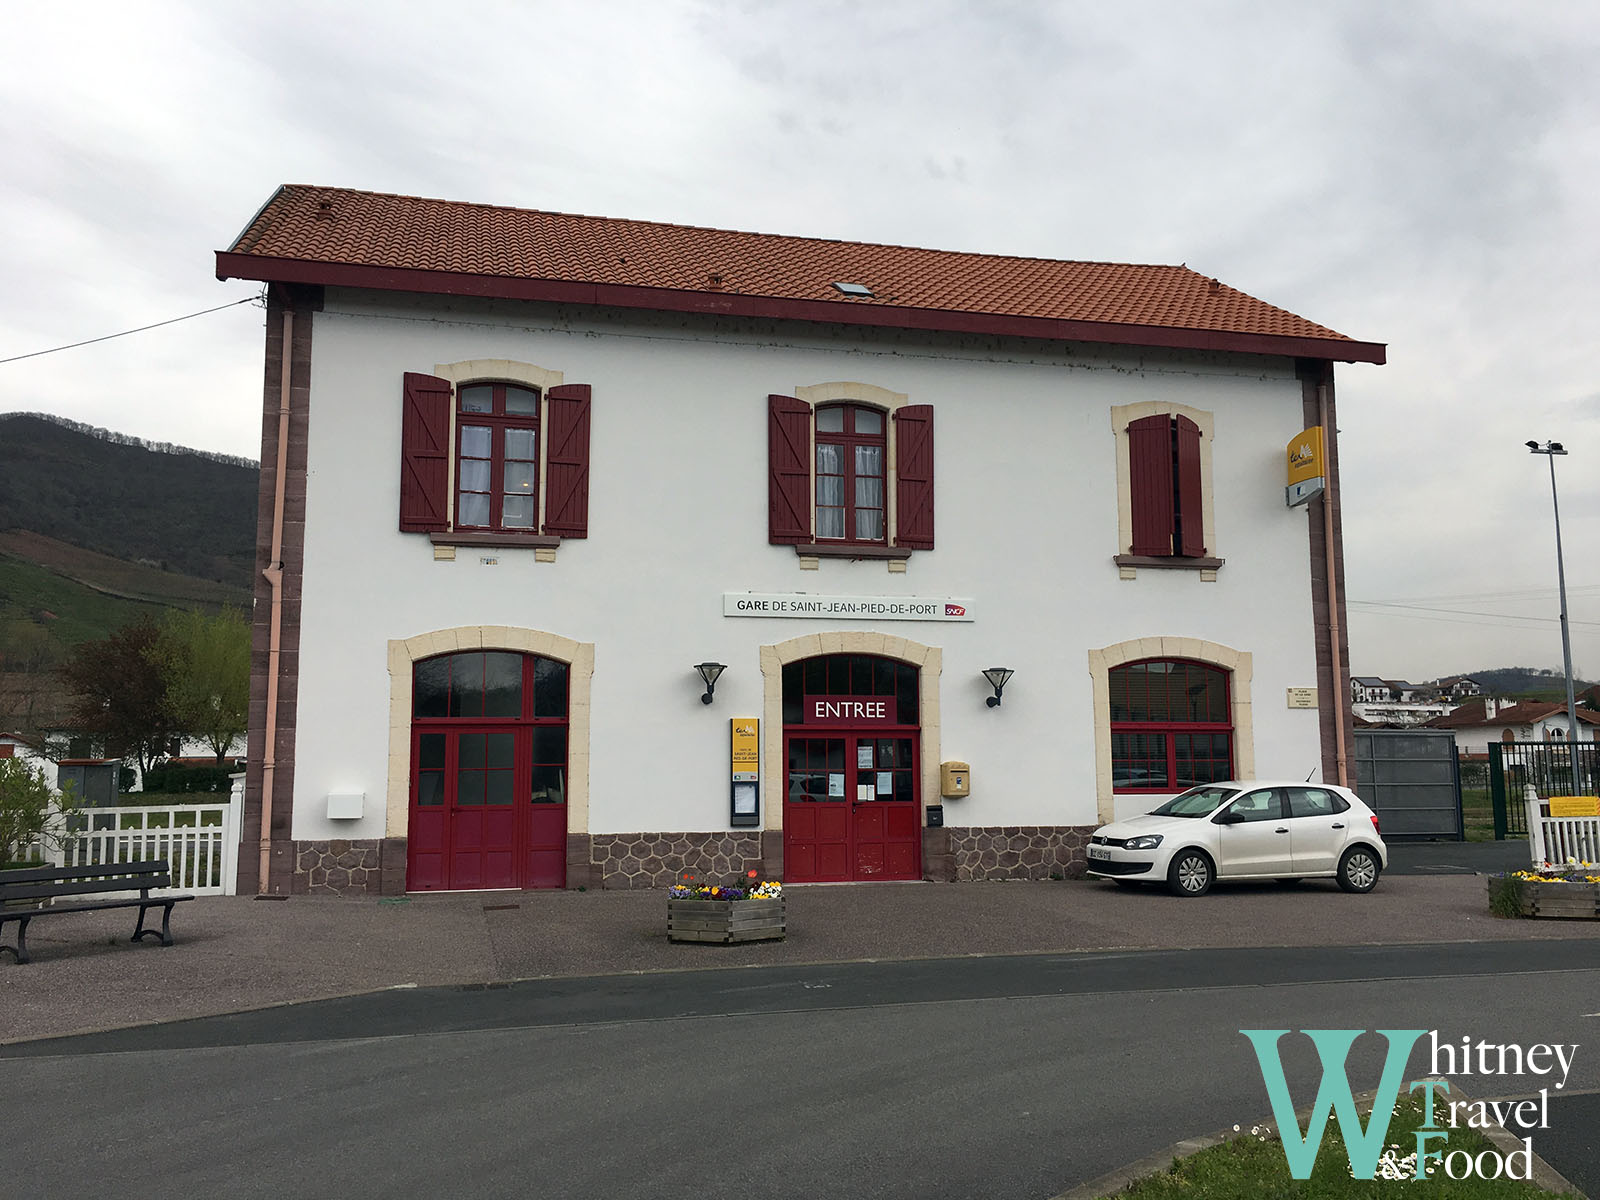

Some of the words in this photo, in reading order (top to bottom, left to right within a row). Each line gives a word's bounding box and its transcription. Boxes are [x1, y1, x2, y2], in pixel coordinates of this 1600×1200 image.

[737, 600, 769, 611] GARE
[772, 601, 787, 611] DE
[790, 601, 937, 614] SAINT-JEAN-PIED-DE-PORT
[815, 701, 886, 718] ENTREE
